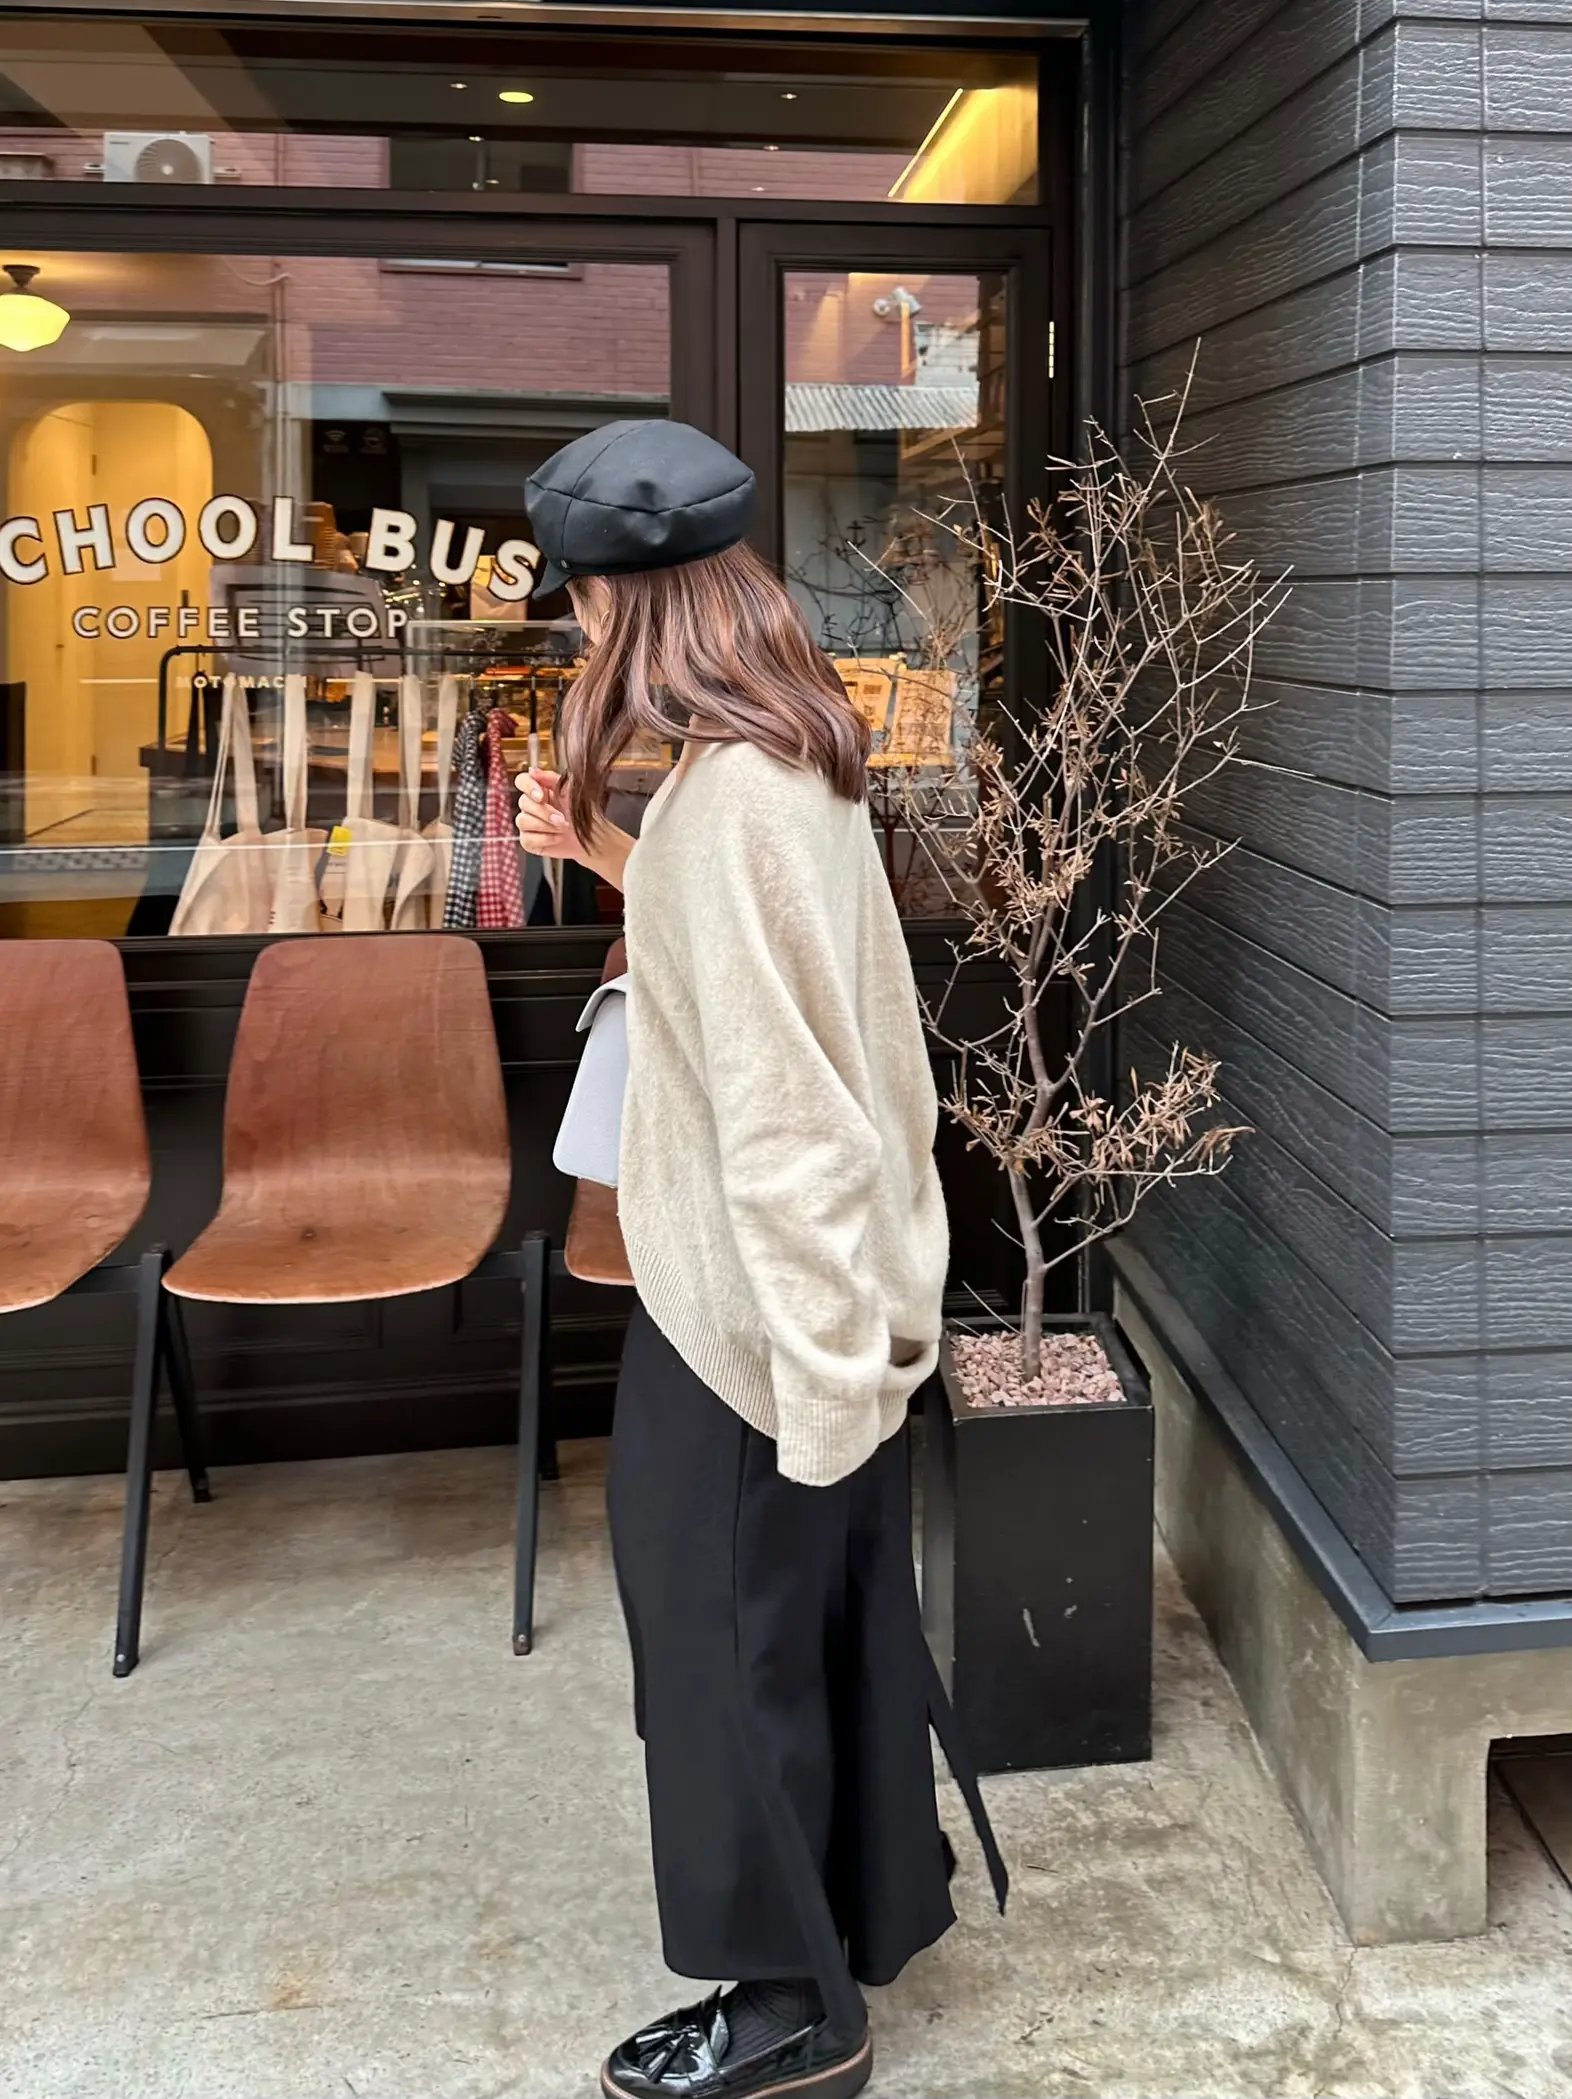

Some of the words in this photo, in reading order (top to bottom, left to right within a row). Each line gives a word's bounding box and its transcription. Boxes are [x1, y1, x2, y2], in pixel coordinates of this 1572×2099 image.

[0, 494, 314, 585] CHOOL
[366, 507, 541, 601] BUS
[72, 605, 260, 638] COFFEE
[287, 606, 408, 639] STOP
[175, 675, 307, 689] MOTMACI
